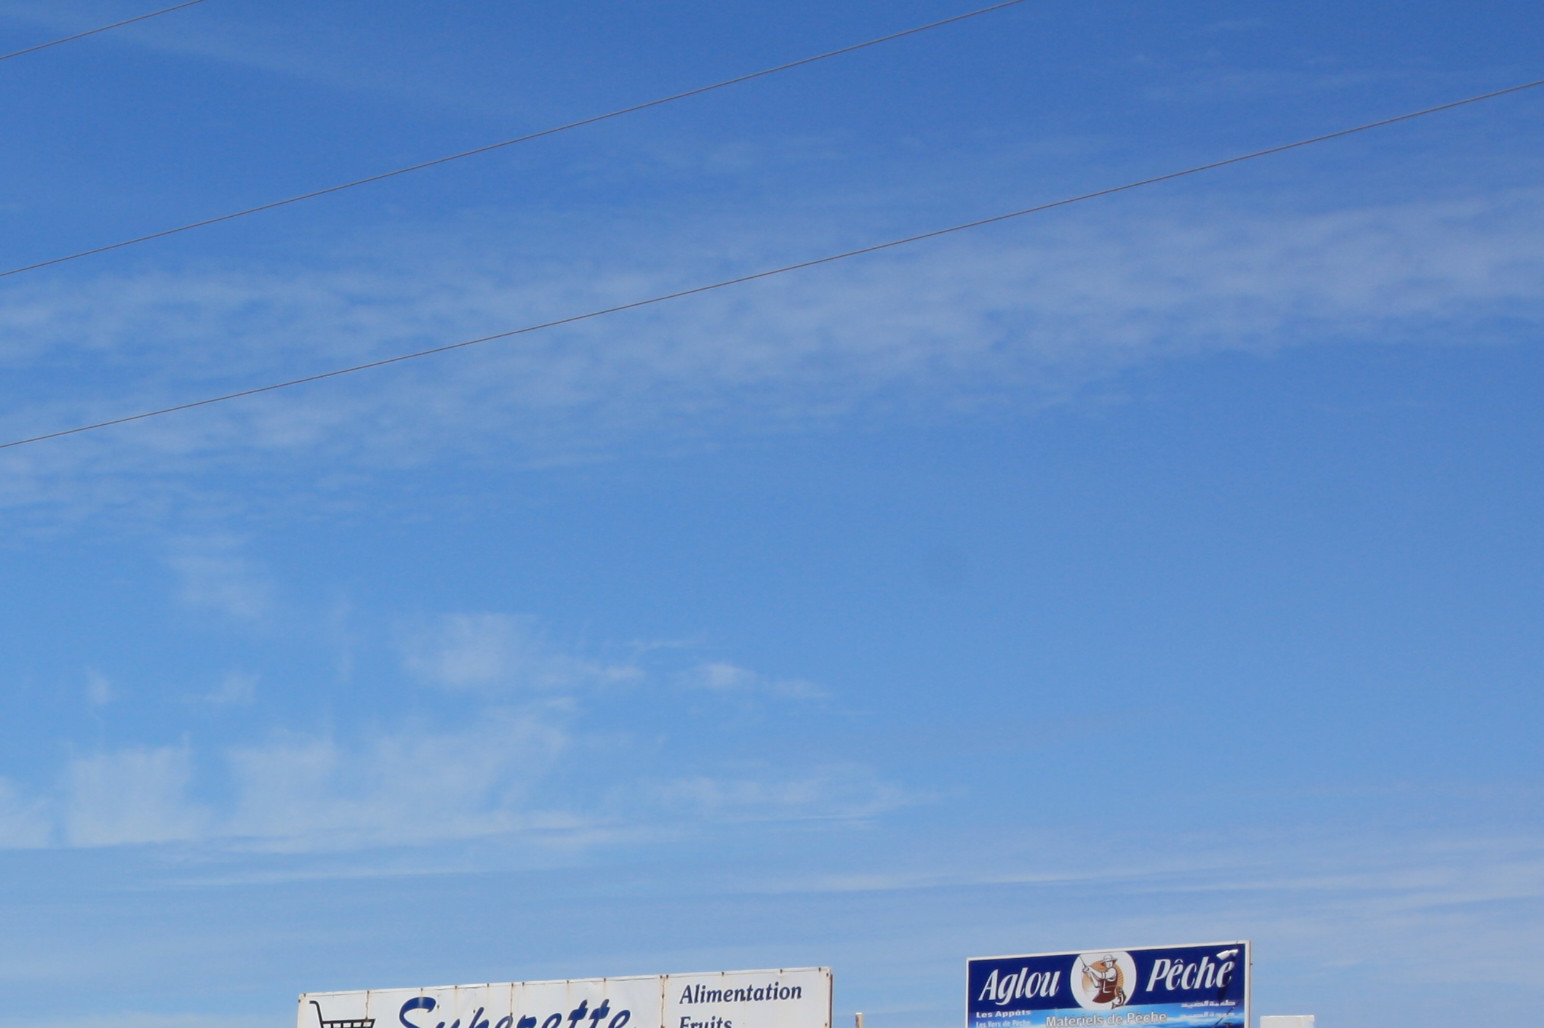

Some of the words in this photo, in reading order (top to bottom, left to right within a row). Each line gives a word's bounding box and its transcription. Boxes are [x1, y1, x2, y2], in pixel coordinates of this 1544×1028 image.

[679, 982, 803, 1005] Alimentation
[978, 967, 1061, 1006] Aglou
[1107, 1013, 1123, 1026] de
